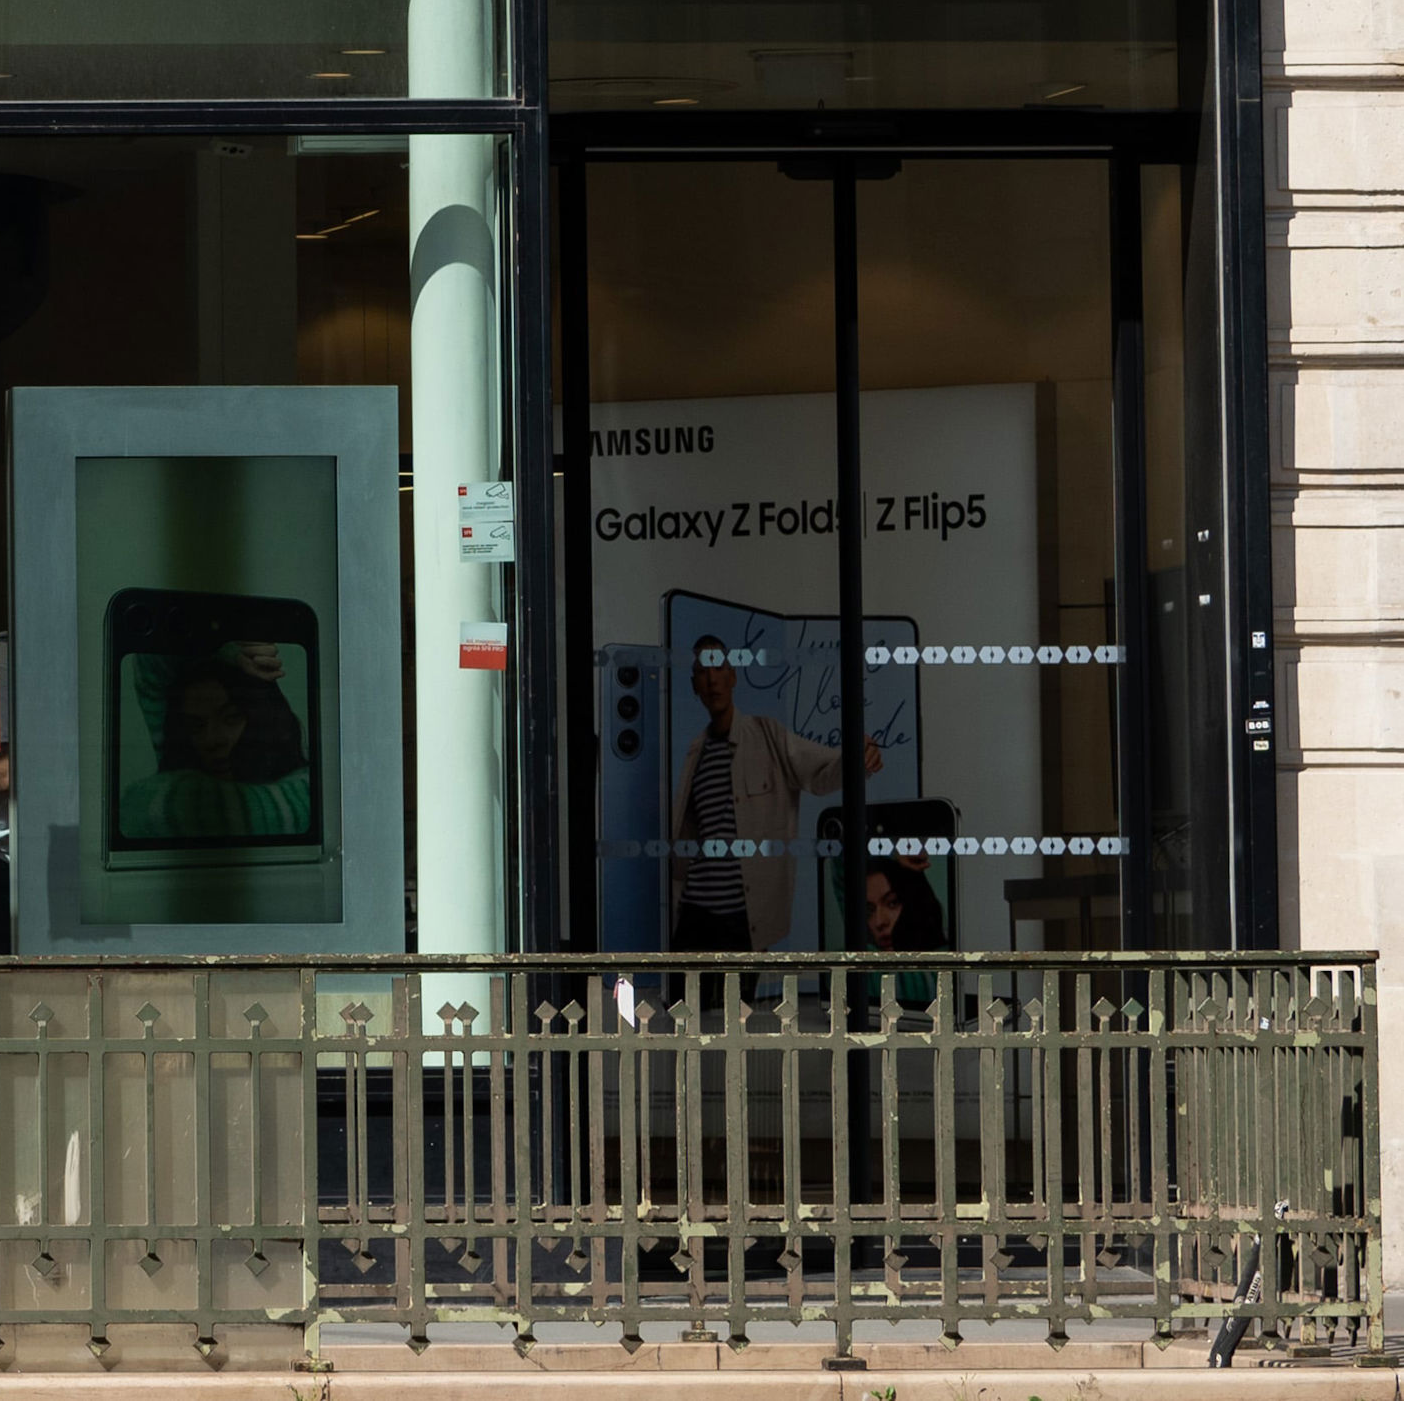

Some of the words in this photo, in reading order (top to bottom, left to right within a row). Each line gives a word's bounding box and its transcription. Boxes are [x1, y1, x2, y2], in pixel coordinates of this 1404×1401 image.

[589, 425, 714, 457] AMSUNG
[595, 506, 725, 547] Galaxy
[731, 502, 751, 537] Z
[876, 497, 896, 532] Z
[904, 492, 987, 542] Flip5
